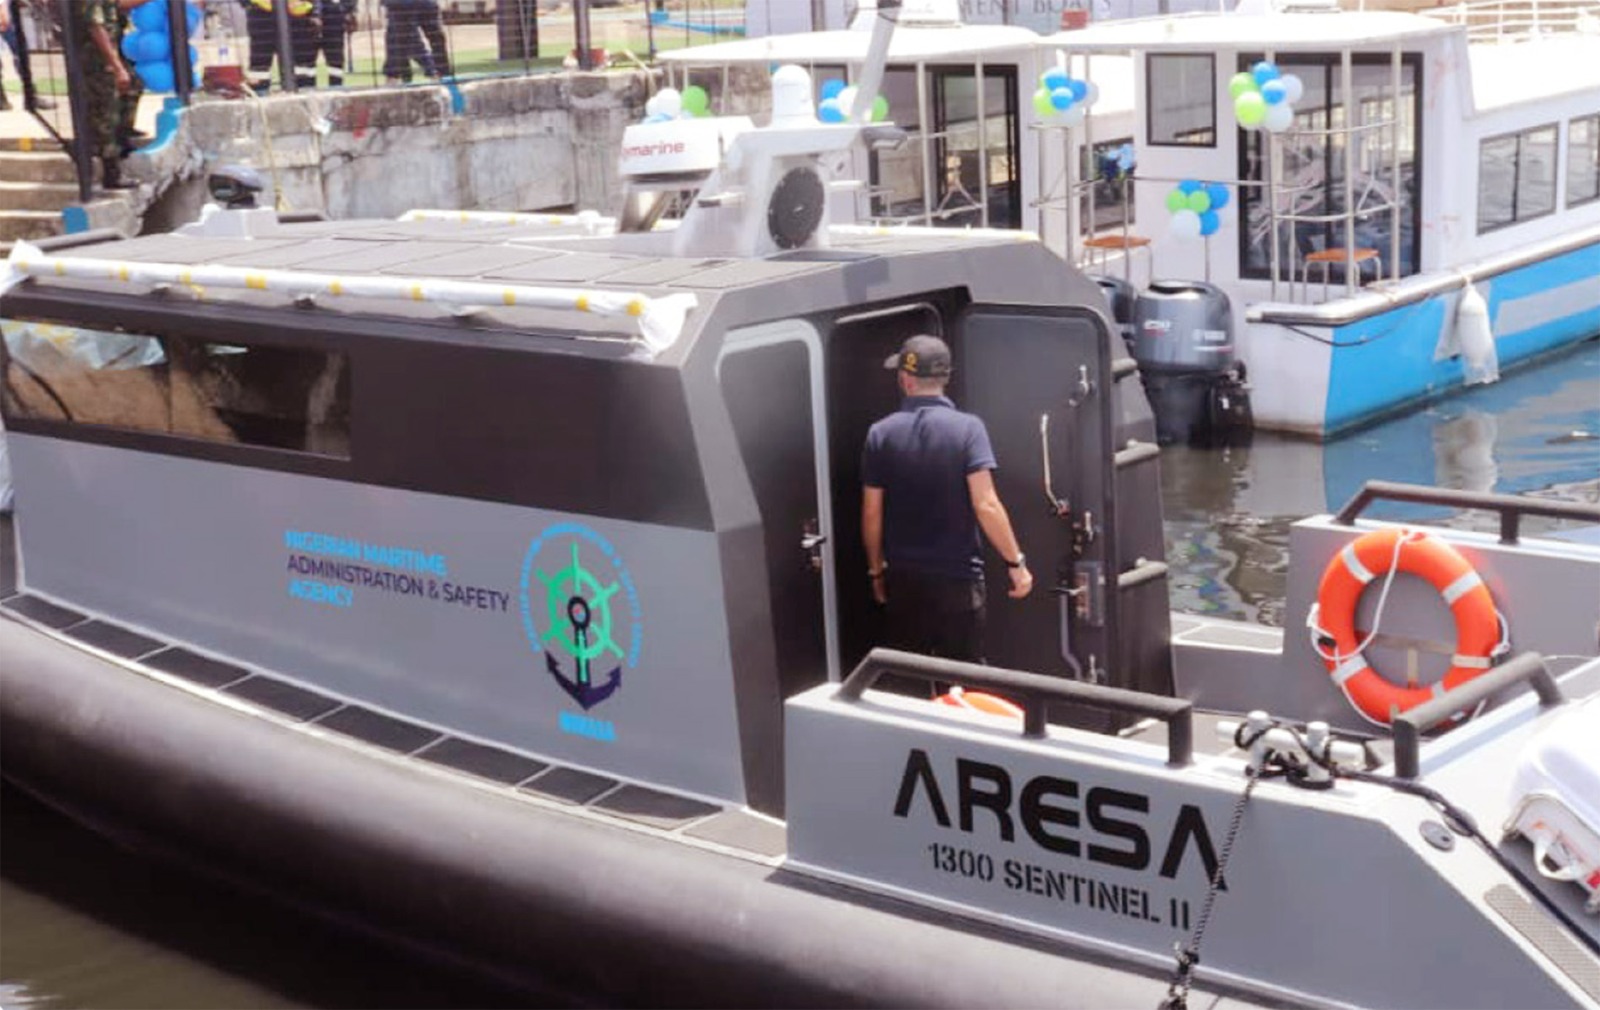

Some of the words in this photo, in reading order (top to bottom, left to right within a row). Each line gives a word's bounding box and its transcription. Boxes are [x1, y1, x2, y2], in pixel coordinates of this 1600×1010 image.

[286, 554, 424, 597] ADMINISTRATION
[428, 579, 440, 600] &
[442, 581, 510, 613] SAFETY
[893, 747, 1229, 892] ARESA
[928, 842, 994, 882] 1300
[1003, 858, 1161, 924] SENTINEL
[1169, 897, 1190, 931] II
